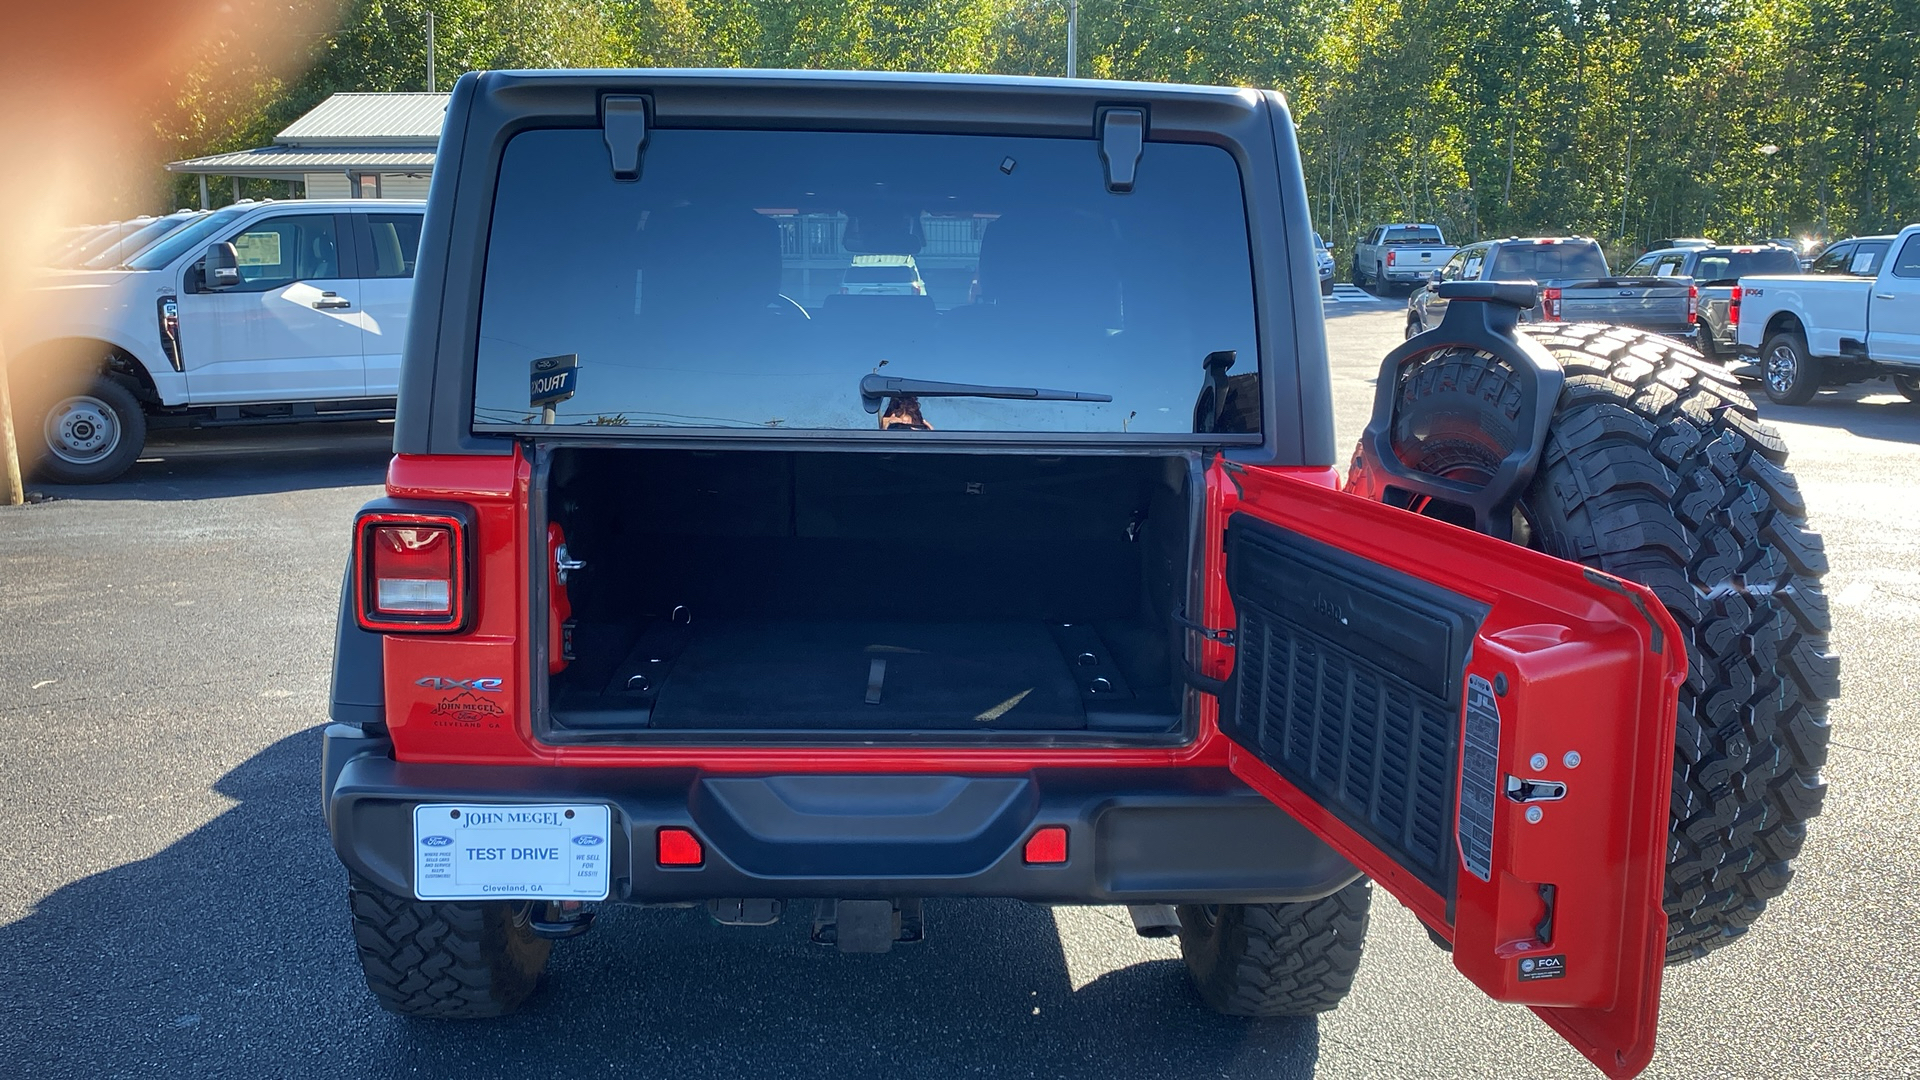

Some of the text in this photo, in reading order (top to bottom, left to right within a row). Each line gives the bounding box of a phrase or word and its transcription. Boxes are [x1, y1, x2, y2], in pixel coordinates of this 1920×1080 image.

[438, 703, 495, 713] JOHN MEGEL
[463, 812, 563, 828] JOHN MEGEL
[466, 848, 559, 860] TEST DRIVE
[482, 884, 543, 893] Cleveland, GA
[1538, 957, 1561, 967] FCA
